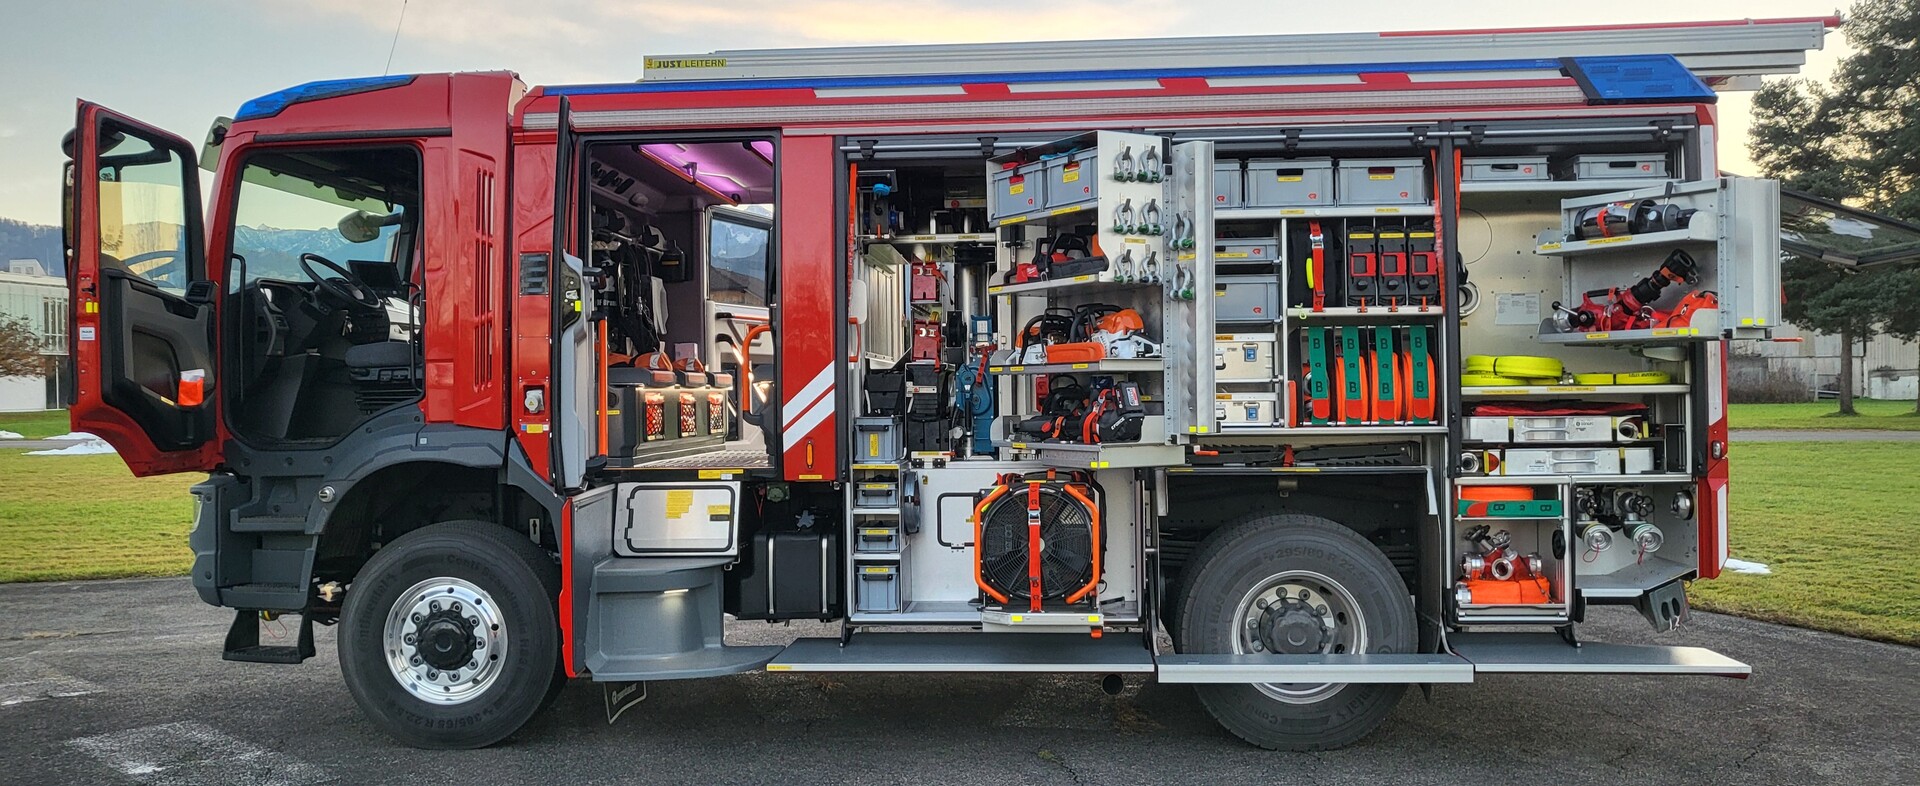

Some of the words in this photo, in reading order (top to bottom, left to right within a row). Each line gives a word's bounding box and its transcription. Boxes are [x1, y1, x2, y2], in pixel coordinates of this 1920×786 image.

[657, 60, 682, 68] JUST
[685, 59, 724, 68] LEITERN
[1313, 338, 1320, 350] B
[1347, 338, 1354, 350] B
[1380, 338, 1388, 349] B
[1414, 337, 1422, 348] B
[1315, 381, 1323, 393] B
[1349, 382, 1356, 393] B
[1382, 383, 1389, 394] B
[1416, 381, 1423, 392] B
[1275, 546, 1324, 559] 295/80
